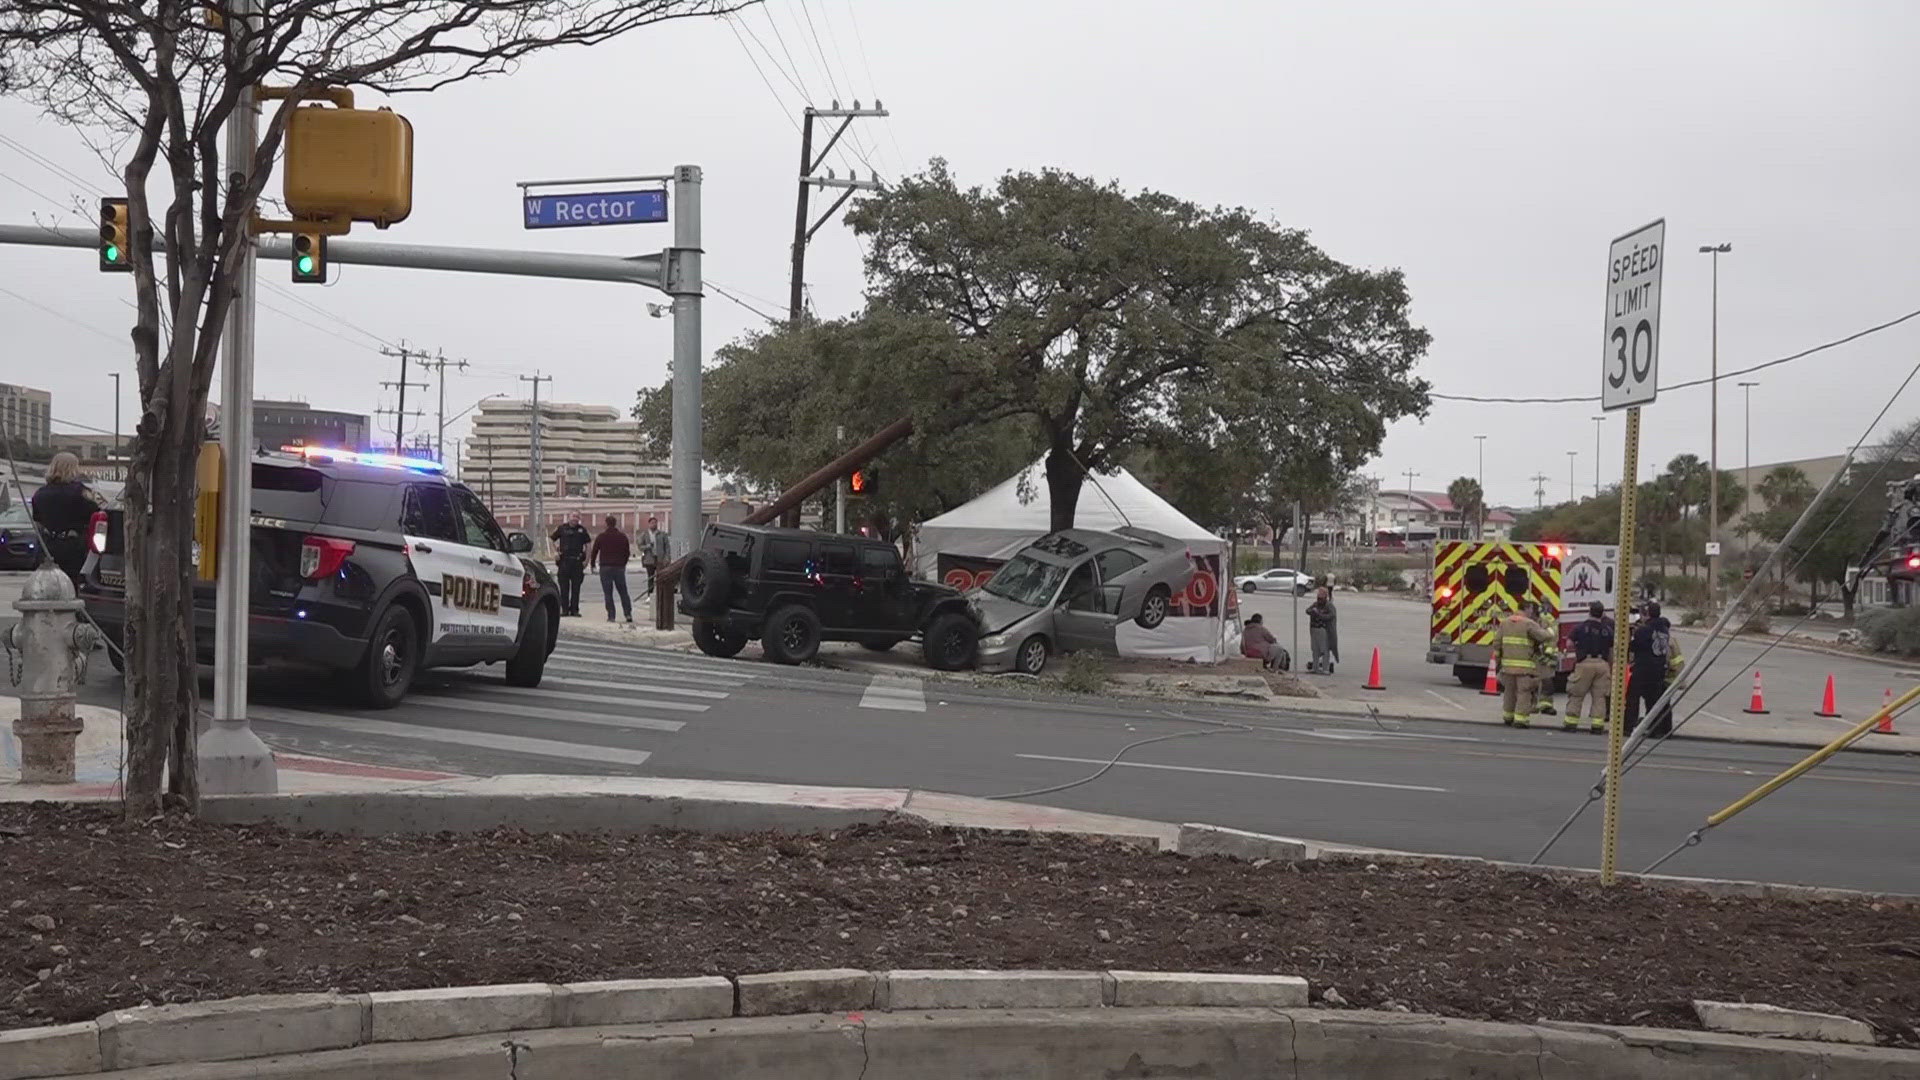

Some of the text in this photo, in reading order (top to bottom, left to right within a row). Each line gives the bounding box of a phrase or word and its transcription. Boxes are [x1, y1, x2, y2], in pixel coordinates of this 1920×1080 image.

[528, 200, 541, 215] W
[555, 199, 635, 221] Rector
[1612, 244, 1658, 284] SPEED
[1614, 282, 1651, 318] LIMIT
[1608, 319, 1652, 389] 30
[249, 516, 287, 529] LICE
[442, 573, 500, 615] POLICE
